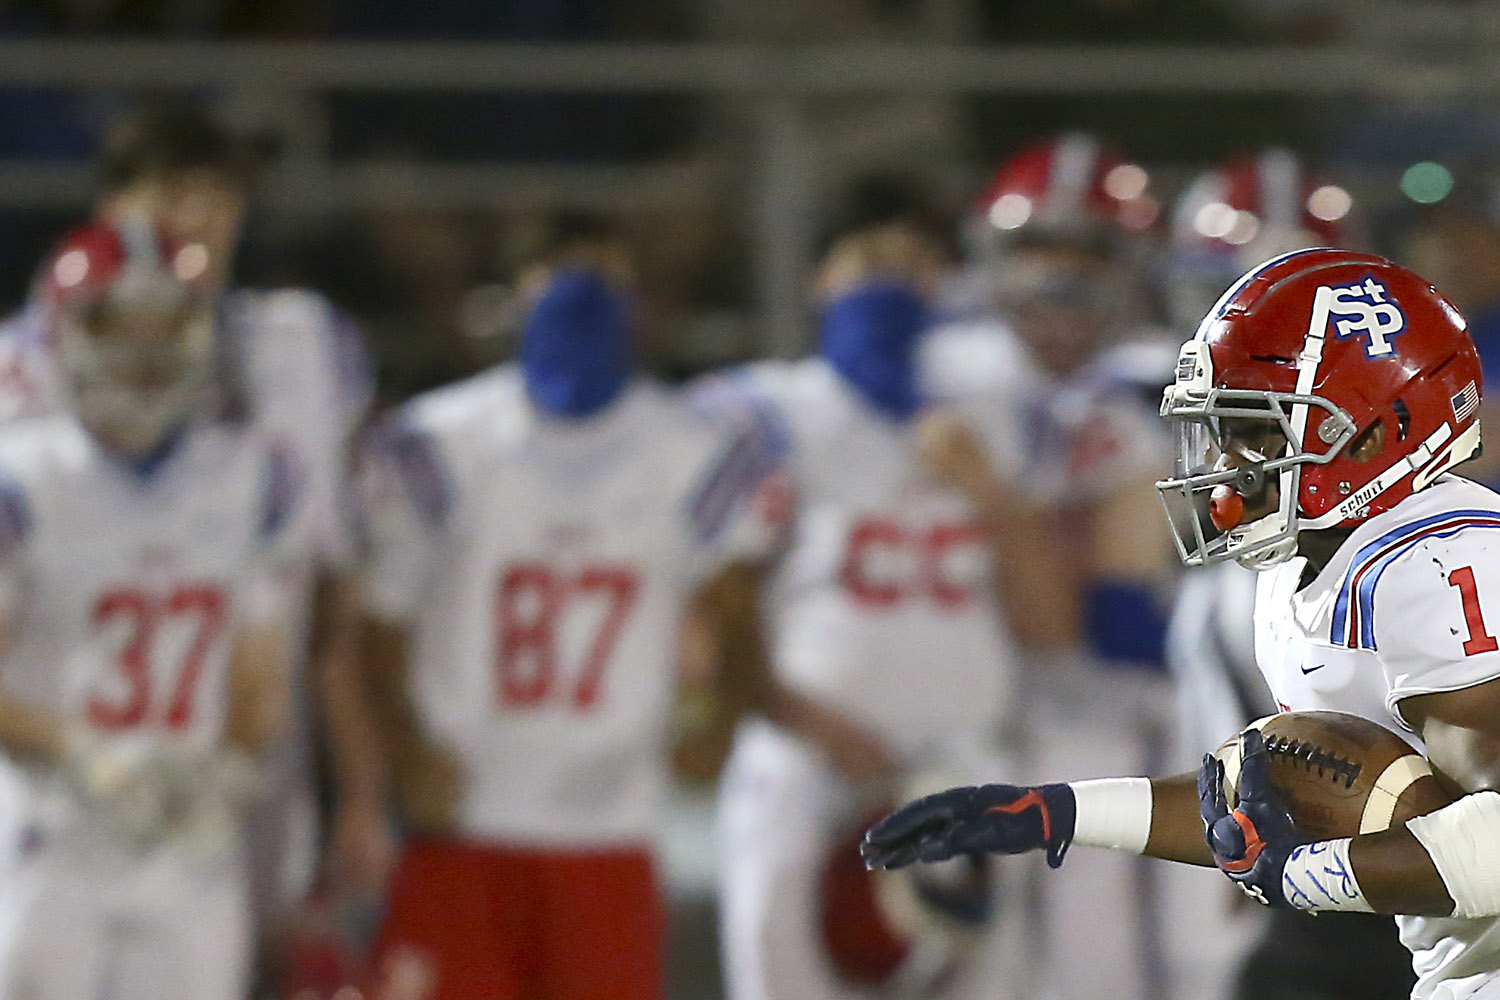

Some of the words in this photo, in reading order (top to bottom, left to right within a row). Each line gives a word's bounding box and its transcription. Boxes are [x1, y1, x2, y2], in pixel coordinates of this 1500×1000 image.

[85, 583, 230, 732] 37
[494, 563, 640, 711] 87
[1448, 565, 1499, 657] 1
